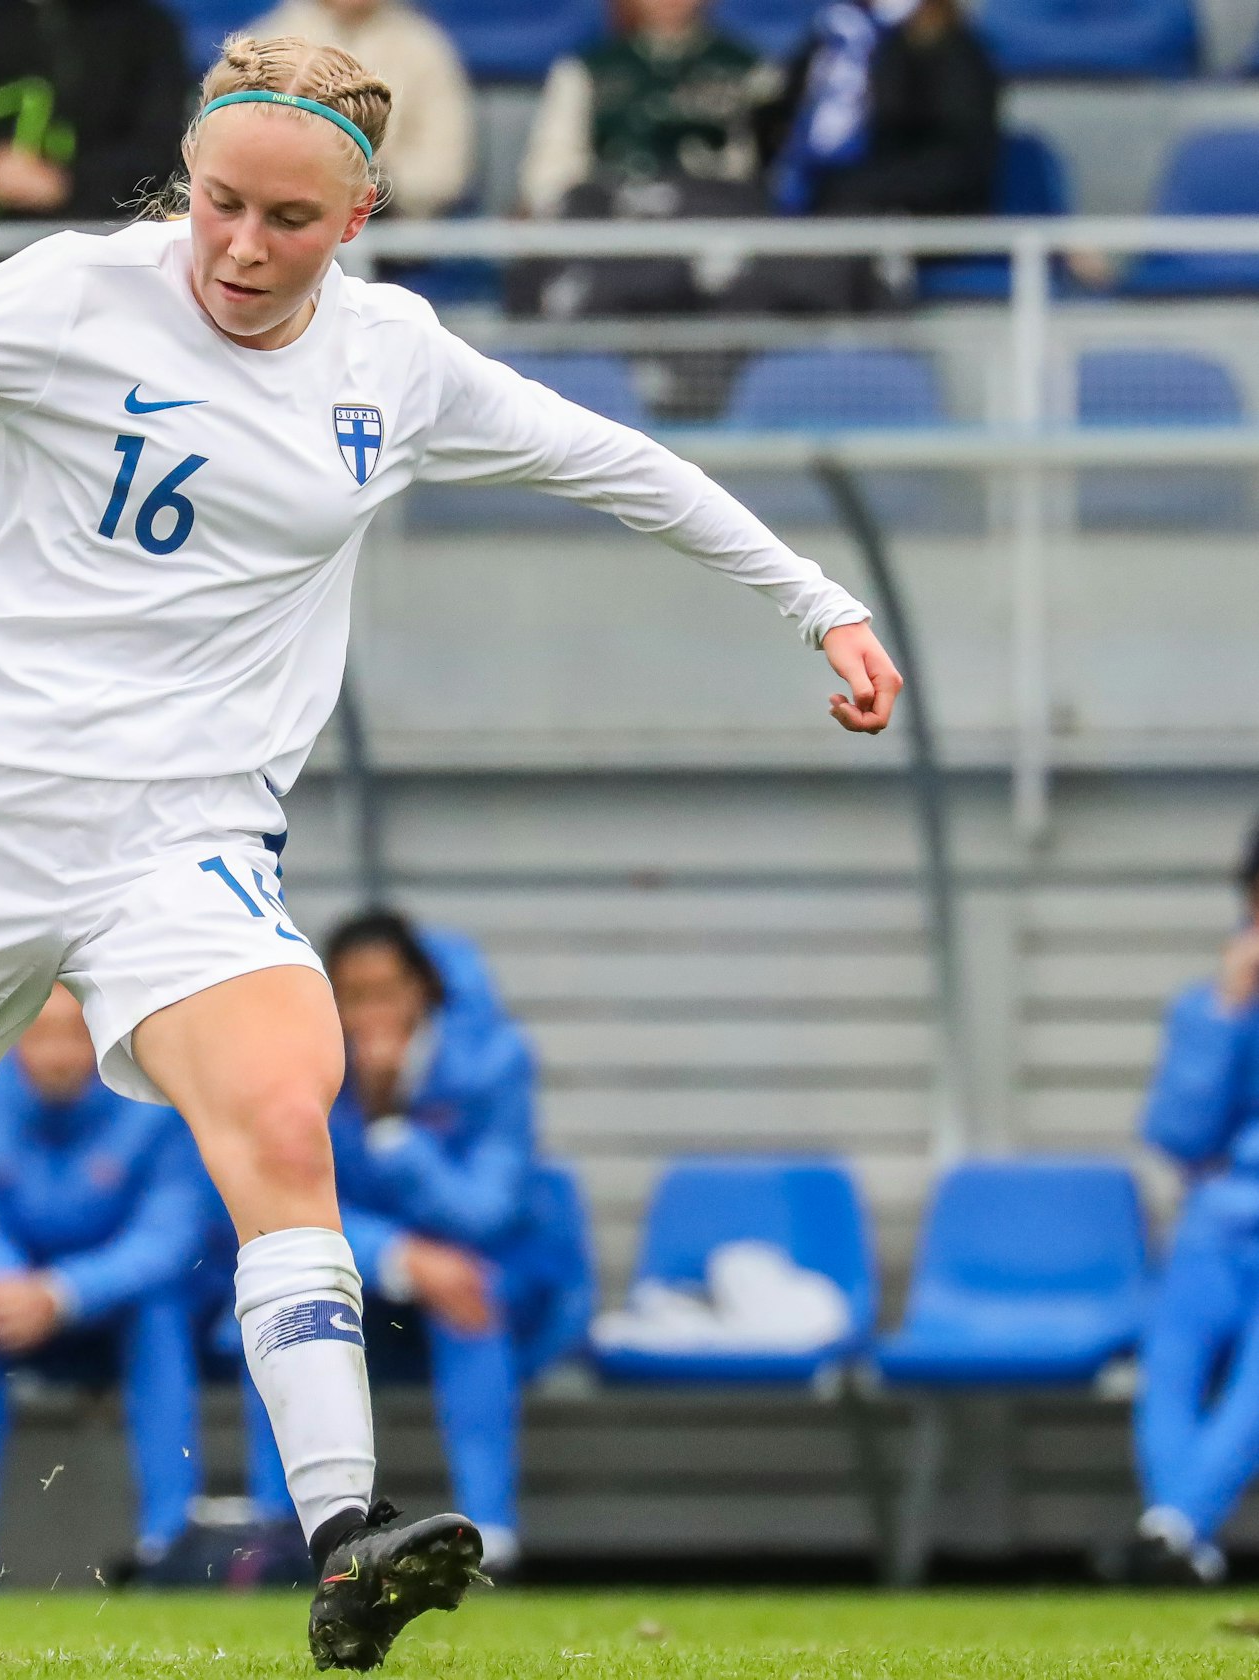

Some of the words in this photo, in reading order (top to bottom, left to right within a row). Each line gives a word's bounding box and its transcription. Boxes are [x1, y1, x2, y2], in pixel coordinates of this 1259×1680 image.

[272, 93, 297, 105] NIKE
[338, 410, 375, 420] SUOMI
[98, 434, 209, 555] 16
